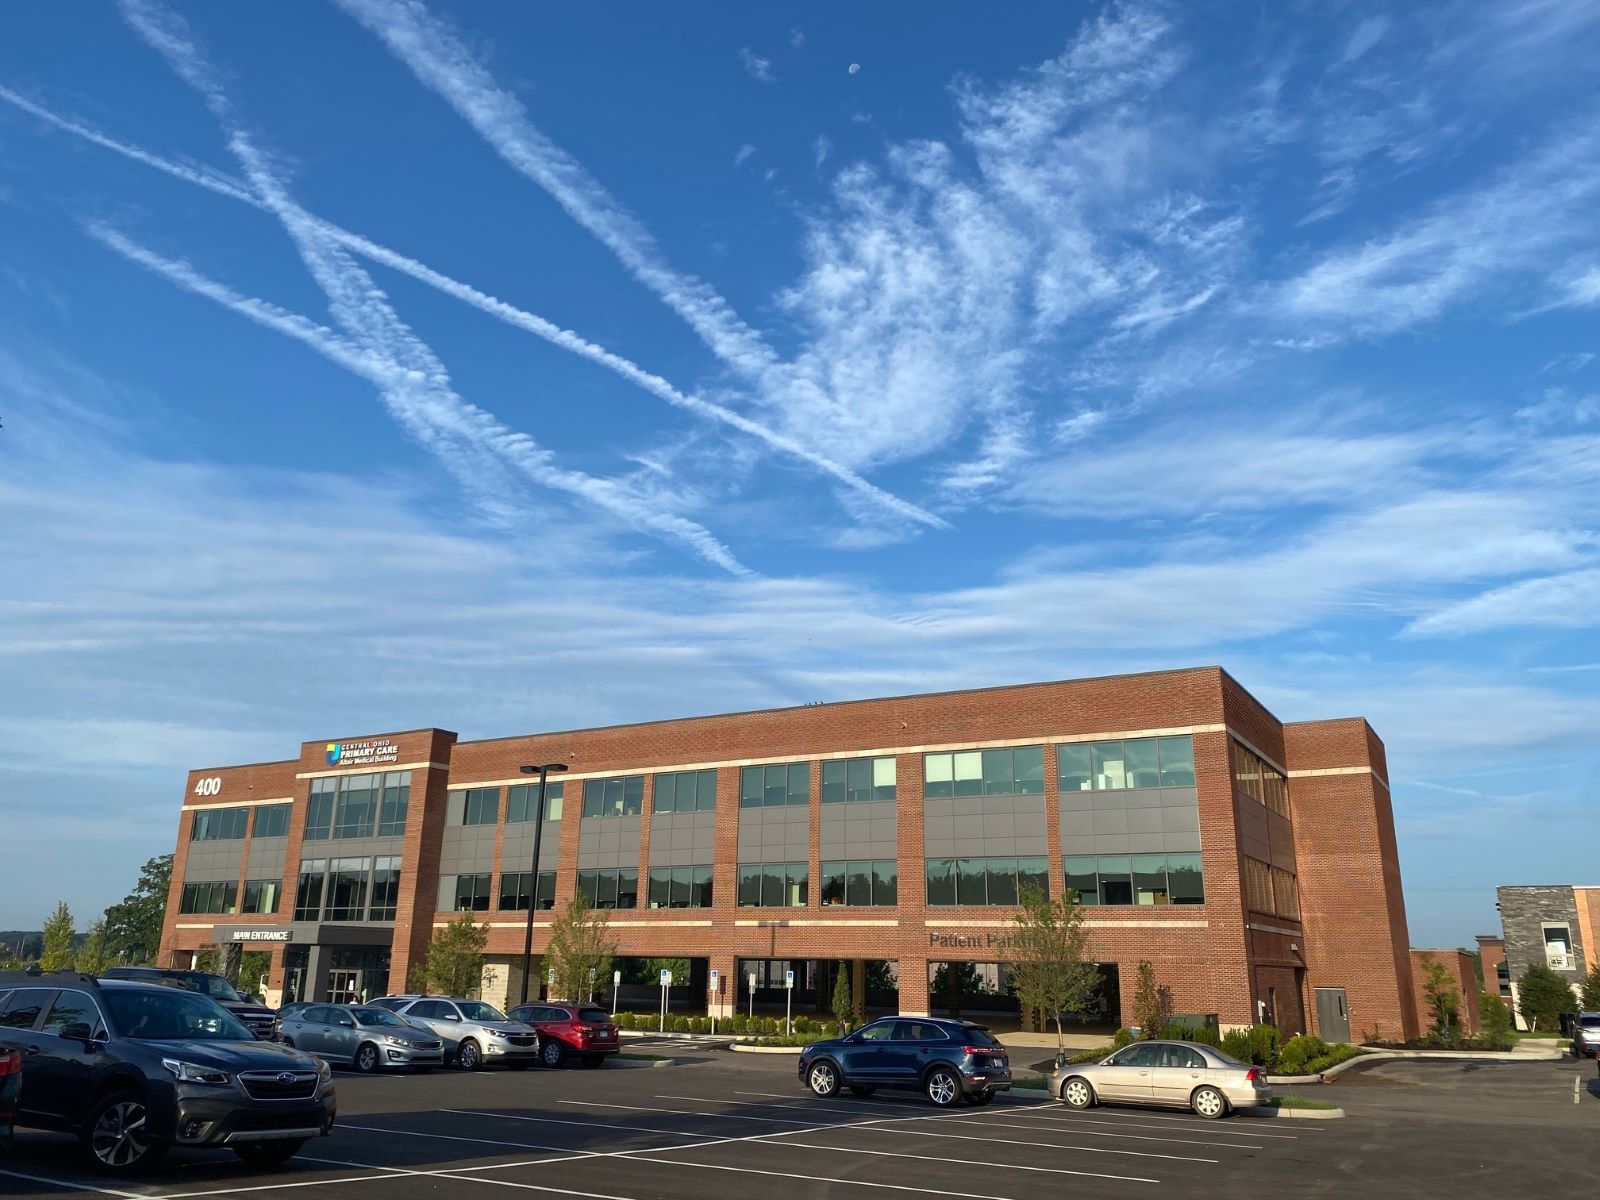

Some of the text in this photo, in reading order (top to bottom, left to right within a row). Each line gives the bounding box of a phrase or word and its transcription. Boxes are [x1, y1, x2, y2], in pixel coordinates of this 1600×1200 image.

[340, 745, 399, 759] PRIMARY CARE
[341, 742, 371, 751] CENTRAL
[194, 777, 222, 796] 400
[232, 931, 288, 940] MAIN ENTRANCE
[930, 932, 982, 948] Patient
